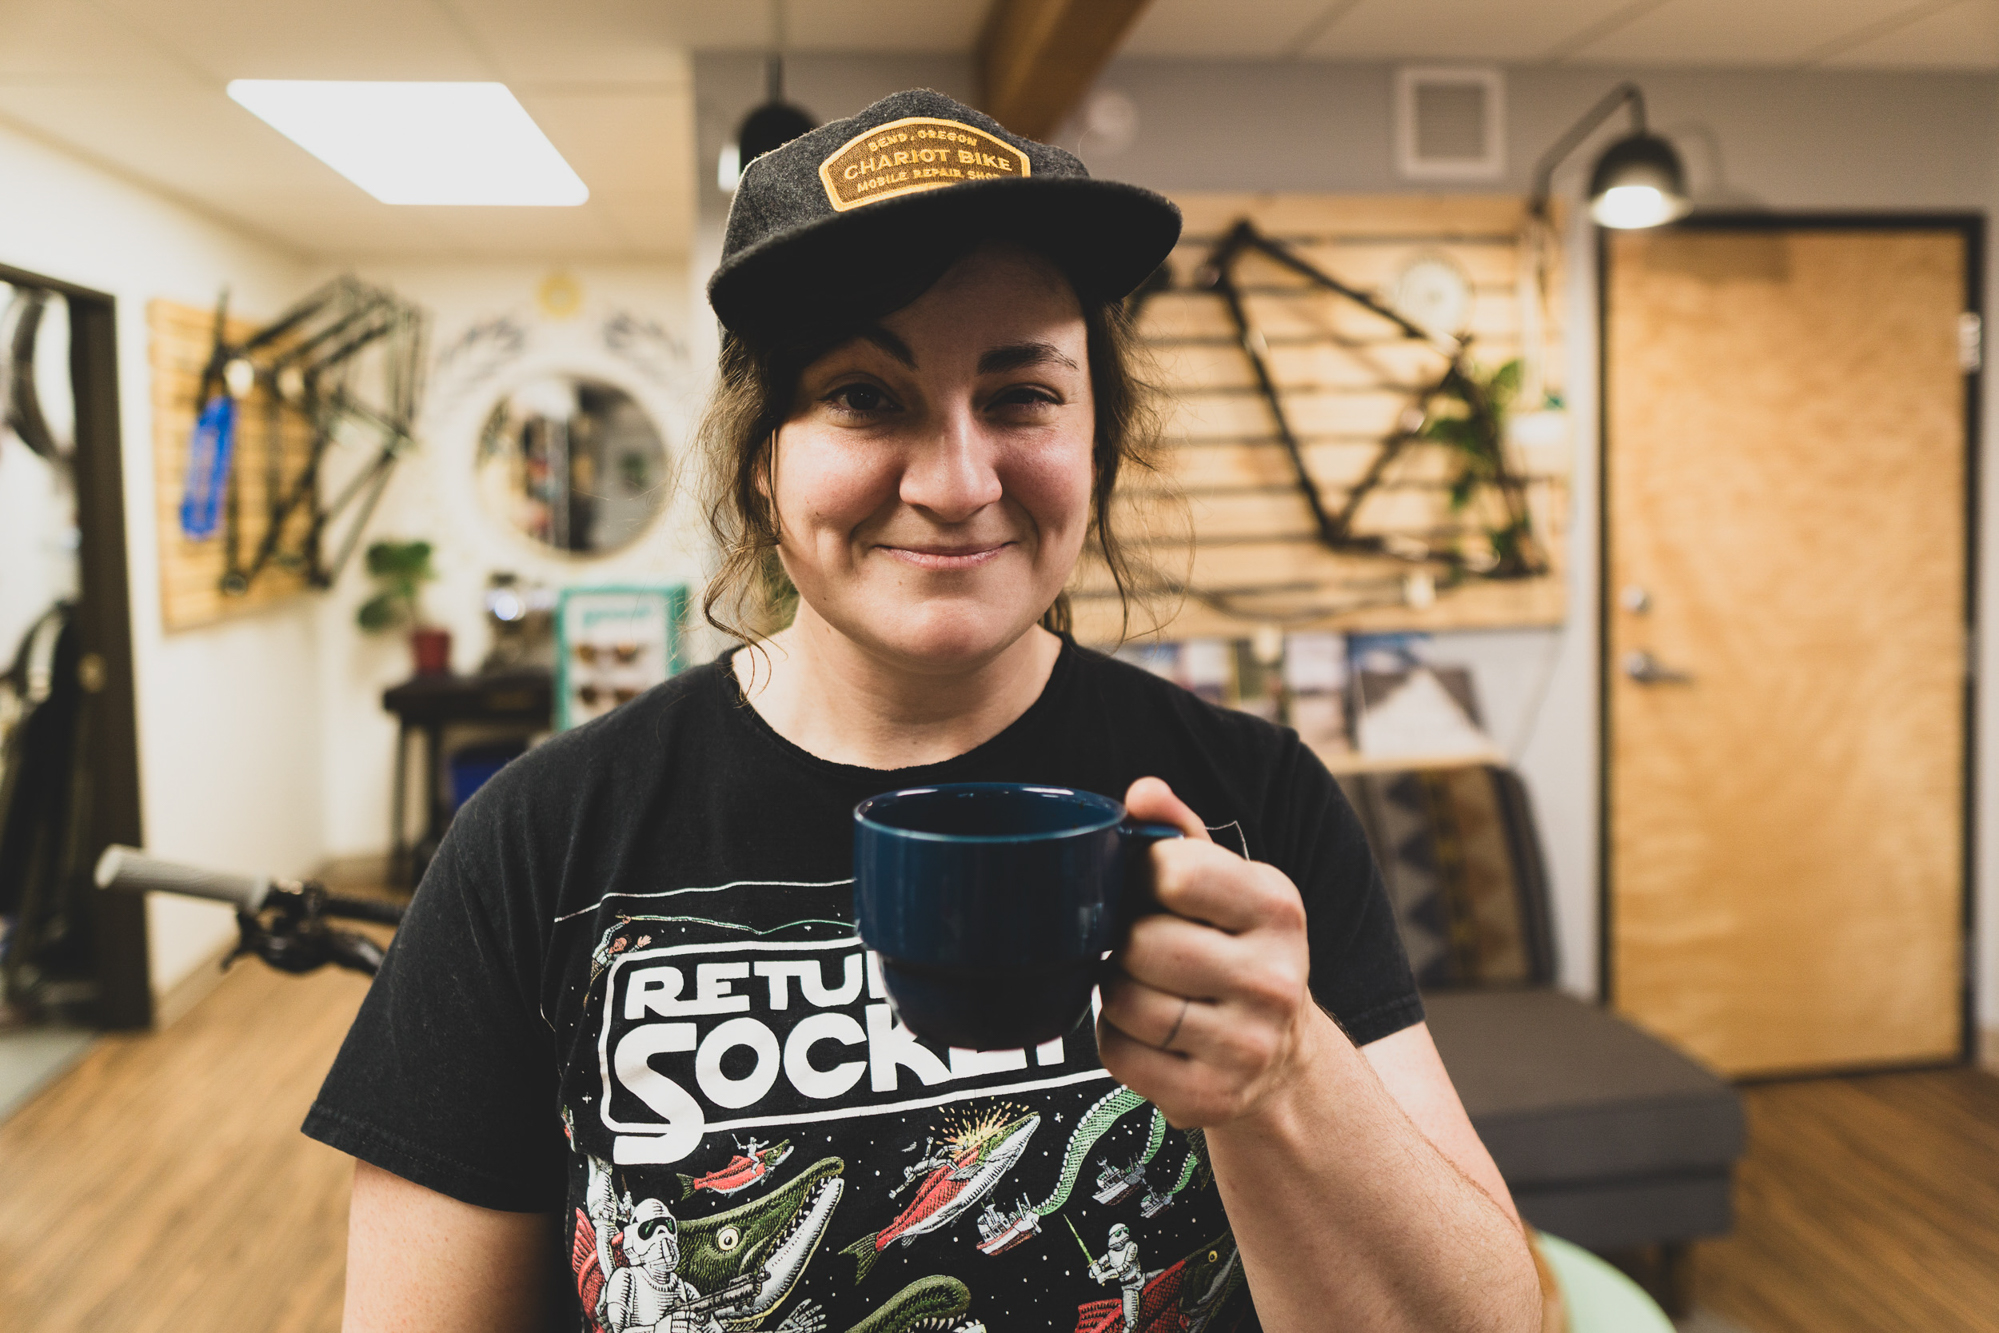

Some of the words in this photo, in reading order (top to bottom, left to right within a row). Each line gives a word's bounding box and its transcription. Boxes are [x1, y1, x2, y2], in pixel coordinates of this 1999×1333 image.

[917, 129, 978, 147] OREGON
[844, 149, 951, 180] CHARIOT
[958, 150, 1012, 172] BIKE
[857, 172, 909, 193] MOBILE
[913, 168, 965, 178] REPAIR
